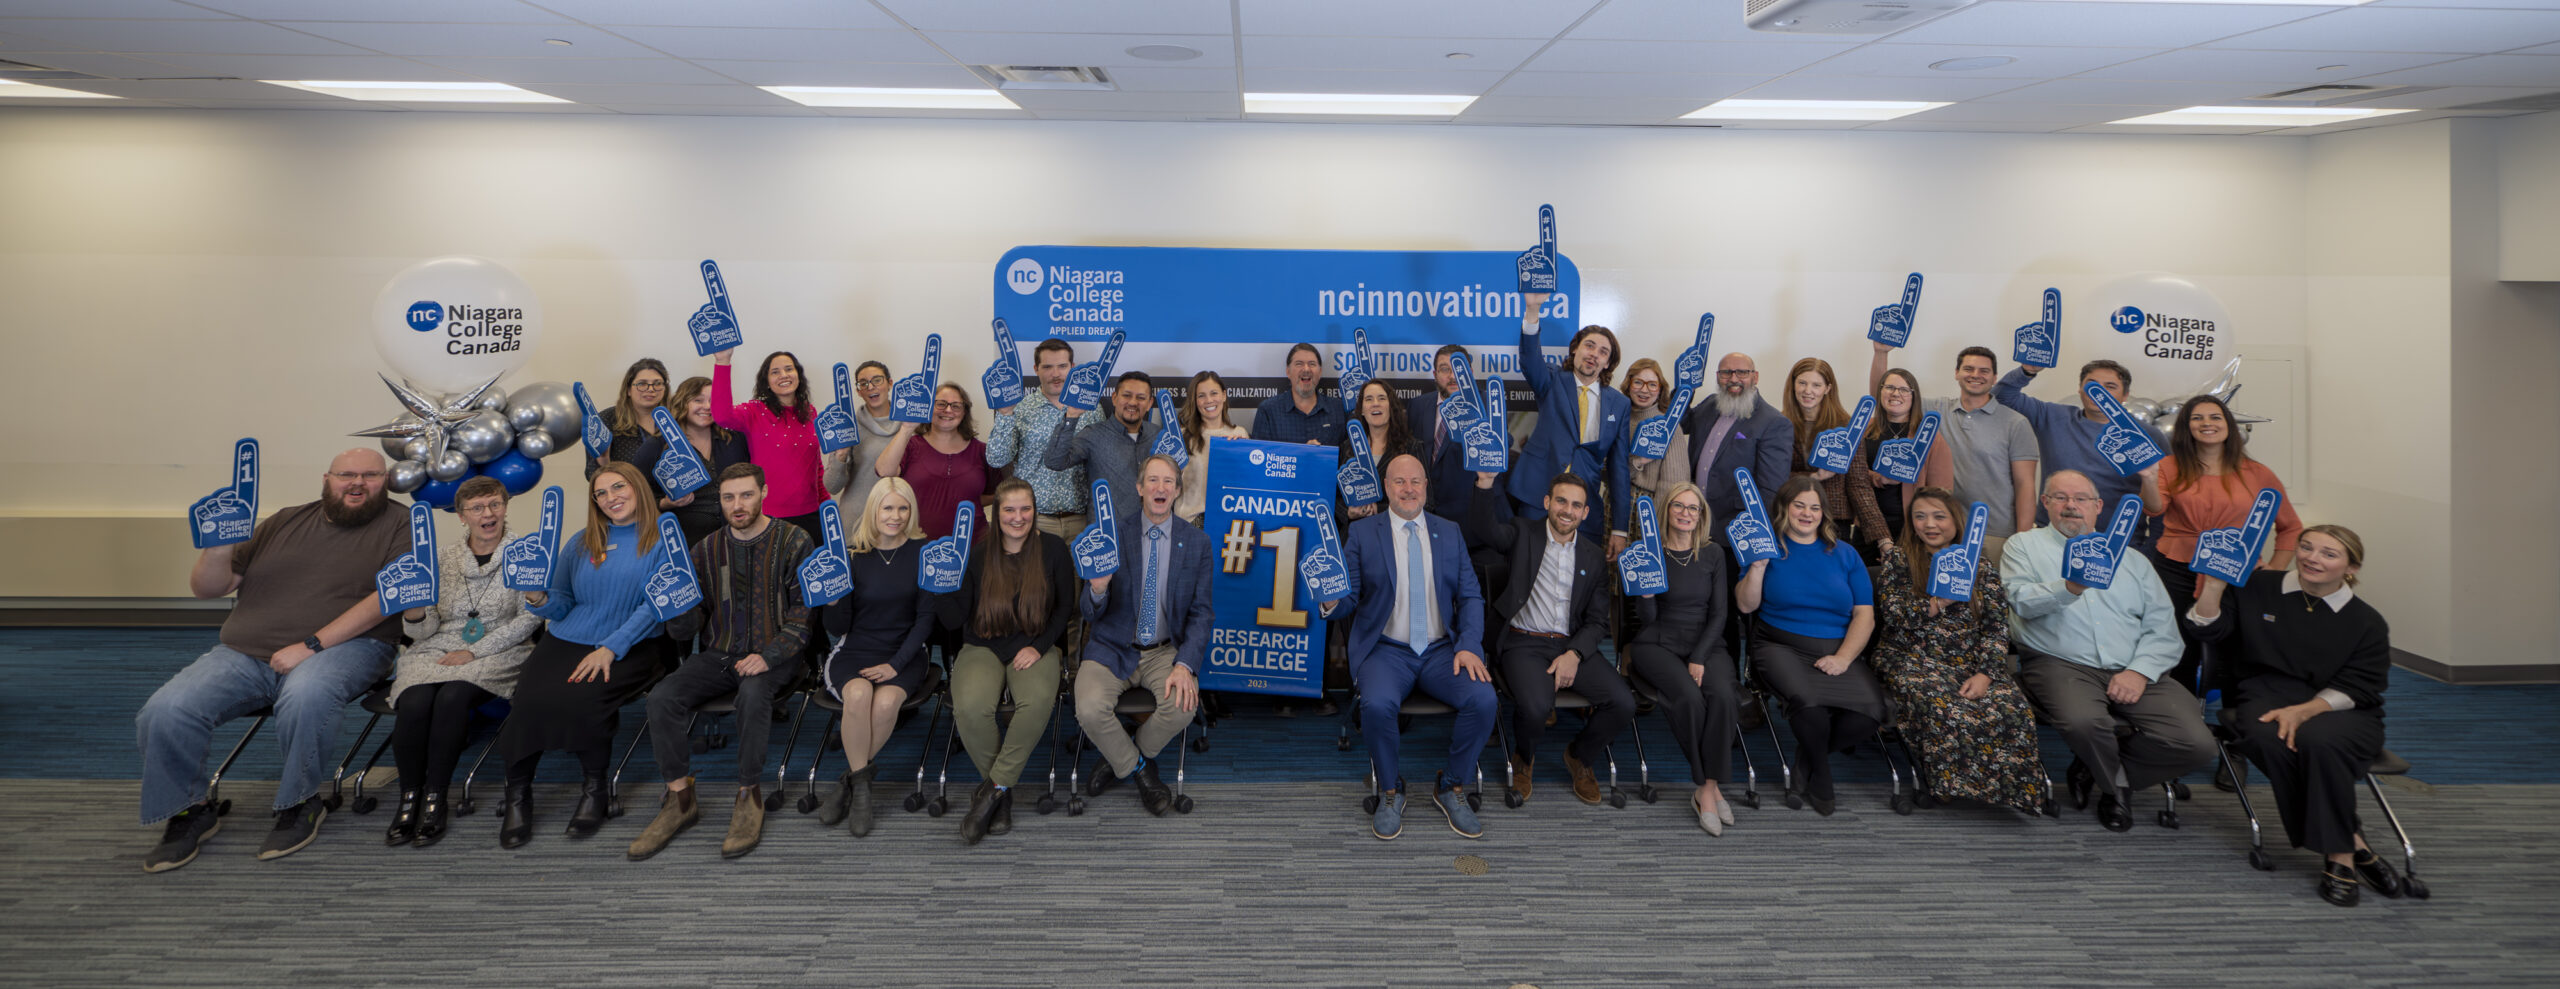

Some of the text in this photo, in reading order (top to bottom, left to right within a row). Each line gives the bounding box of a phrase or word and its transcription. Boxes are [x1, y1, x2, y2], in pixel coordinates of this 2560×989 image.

[1014, 269, 1037, 283] nc
[1049, 266, 1123, 288] Niagara
[1049, 284, 1124, 307] College
[412, 309, 437, 323] nc
[448, 304, 523, 324] Niagara
[1049, 303, 1124, 322] Canada
[2116, 313, 2139, 325] nc
[447, 321, 523, 340] College
[1049, 326, 1086, 336] APPLIED
[2146, 313, 2215, 332] Niagara
[446, 337, 521, 355] Canada
[2145, 328, 2215, 348] College
[2144, 343, 2214, 360] Canada
[1252, 453, 1262, 461] nc
[1265, 461, 1297, 471] College
[1266, 453, 1297, 464] Niagara
[1265, 468, 1296, 479] Canada
[1221, 519, 1308, 629] #1
[1212, 628, 1309, 651] RESEARCH
[1210, 647, 1308, 672] COLLEGE
[1247, 679, 1268, 688] 2023
